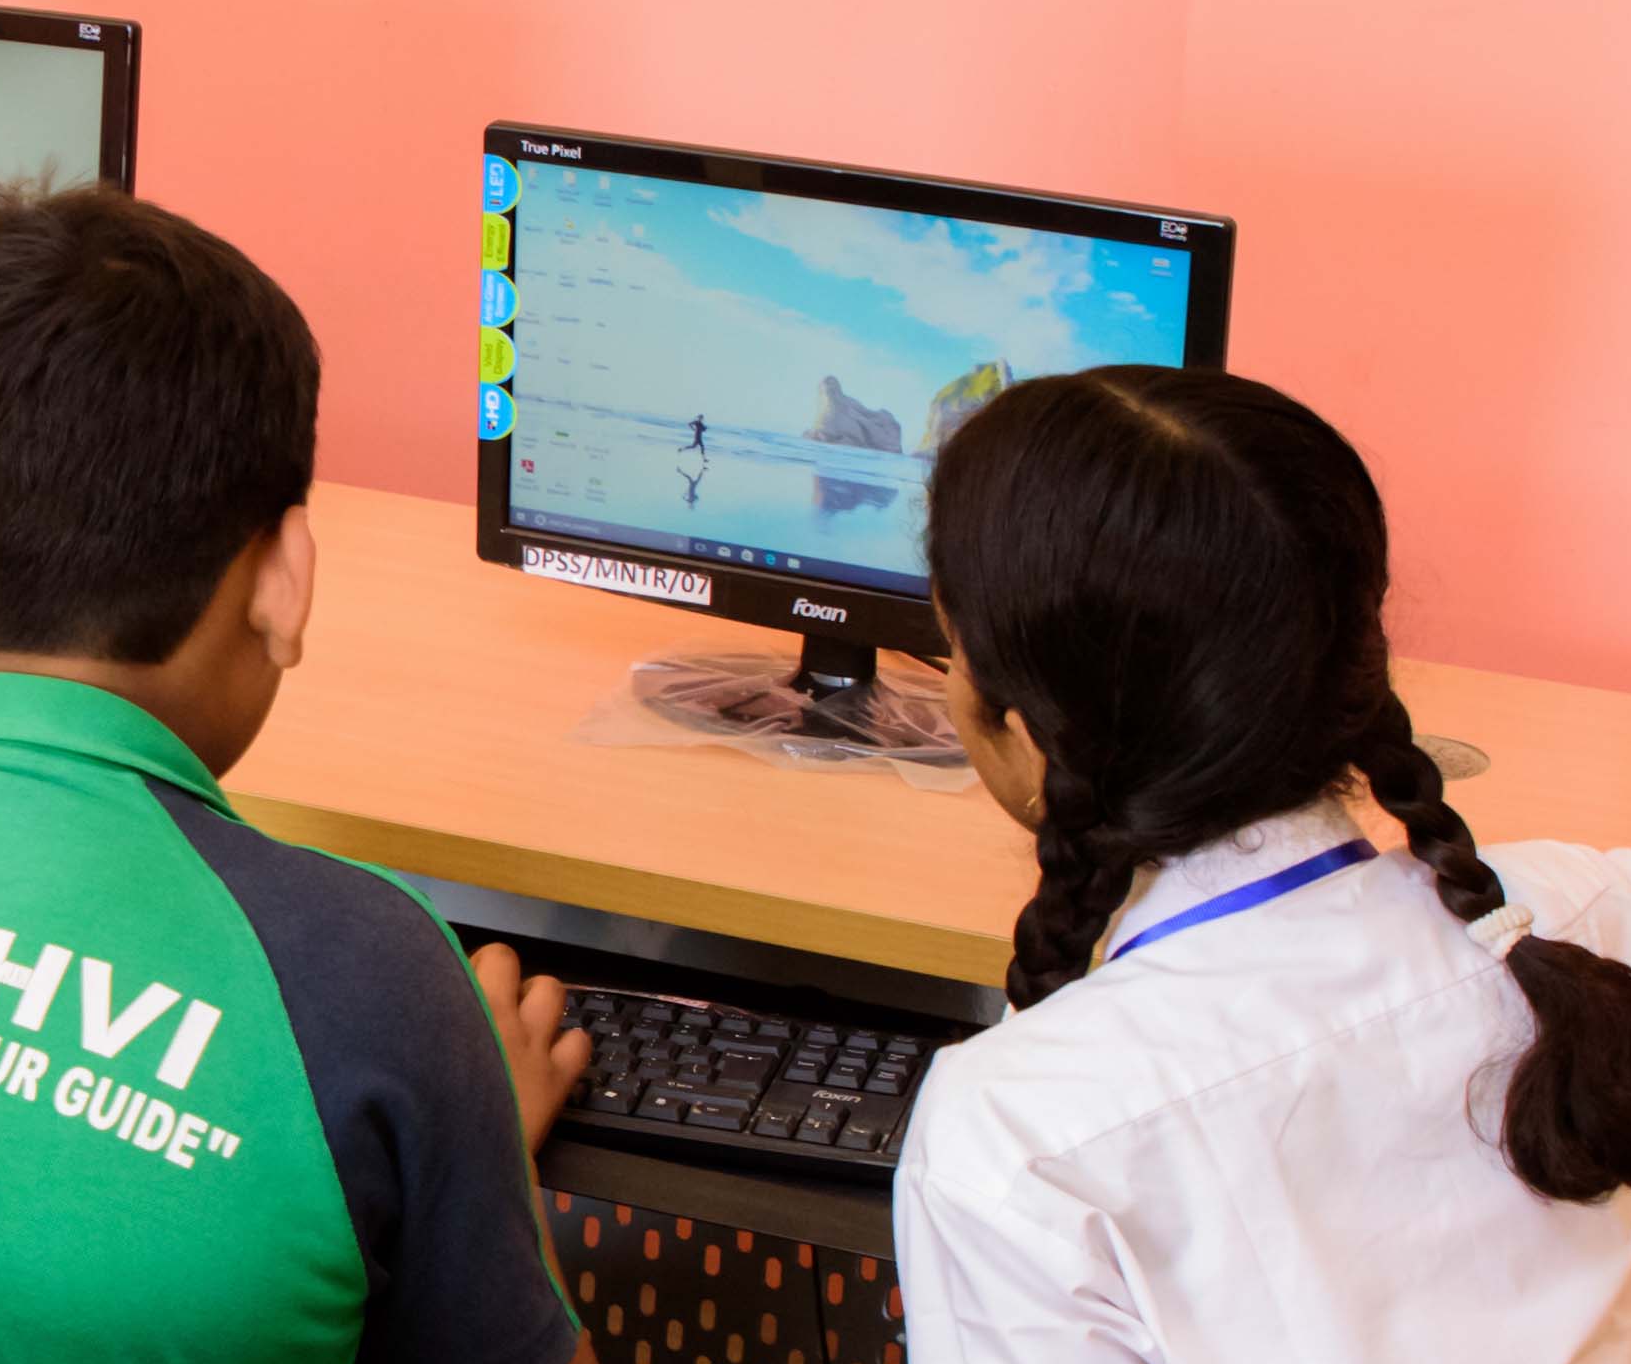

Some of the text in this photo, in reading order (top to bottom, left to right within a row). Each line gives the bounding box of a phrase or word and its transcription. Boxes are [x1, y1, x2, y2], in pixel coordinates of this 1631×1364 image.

[520, 139, 582, 159] True Pixel
[489, 162, 504, 197] LED
[485, 390, 501, 420] HD
[524, 548, 711, 596] DPSS/MNTR/07
[792, 597, 848, 622] foxin
